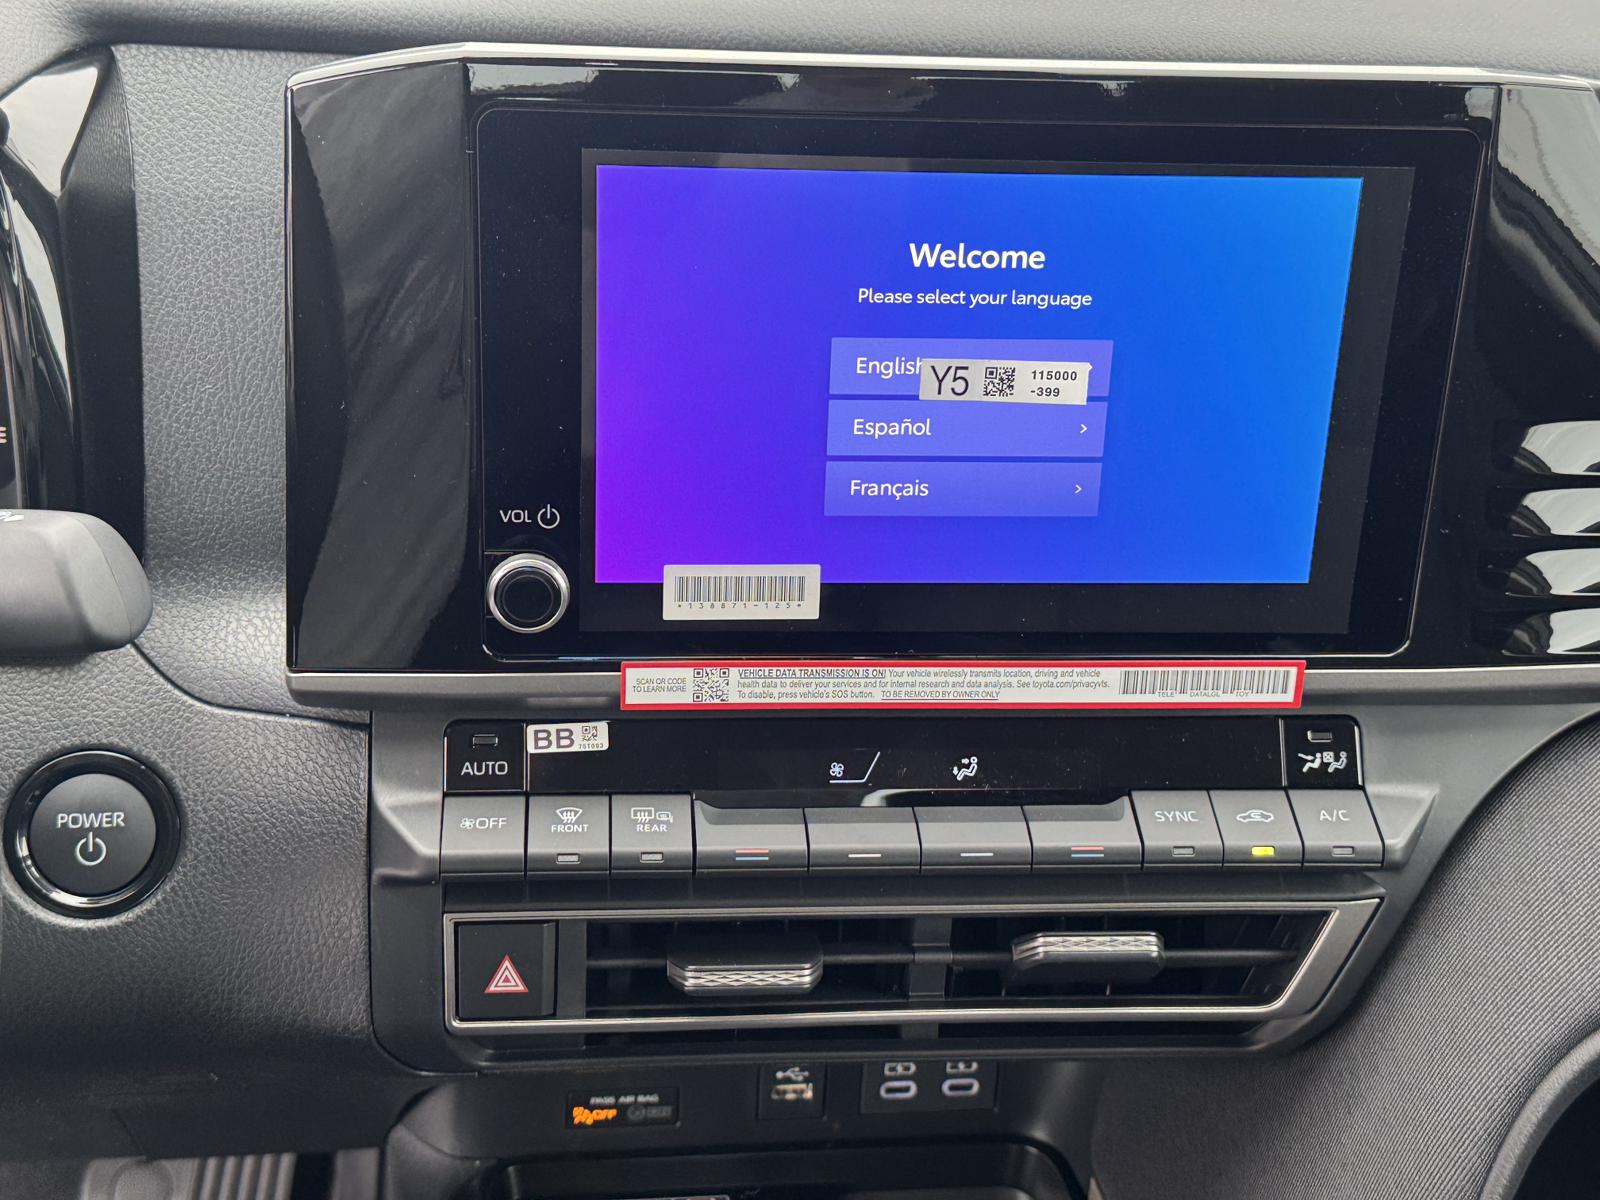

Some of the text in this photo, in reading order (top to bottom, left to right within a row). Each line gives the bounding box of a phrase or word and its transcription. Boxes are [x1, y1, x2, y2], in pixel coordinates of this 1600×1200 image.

[909, 242, 1046, 270] Welcome
[858, 288, 1093, 310] Please select your language
[930, 365, 970, 396] Y5
[1030, 370, 1078, 381] 115000
[1030, 387, 1060, 397] -399
[853, 418, 931, 439] Español
[850, 479, 929, 500] Français
[499, 509, 532, 523] VOL
[738, 669, 1100, 679] VEHICLE DATA TRANSMISSION IS ON! Your vehicle wirelessly transmits location, driving and vehicle
[738, 680, 760, 688] health
[762, 680, 778, 688] data
[780, 680, 787, 688] to
[789, 680, 813, 688] deliver
[814, 681, 830, 690] your
[832, 680, 861, 688] services
[864, 680, 876, 688] and
[878, 680, 888, 688] for
[890, 680, 916, 688] internal
[918, 680, 950, 688] research
[951, 680, 964, 688] and
[966, 680, 982, 688] data
[984, 680, 1014, 689] analysis.
[1016, 680, 1030, 688] See
[738, 690, 746, 698] To
[748, 690, 776, 699] disable,
[778, 692, 798, 700] press
[799, 690, 830, 698] vehicle's
[832, 690, 848, 698] SOS
[850, 690, 875, 698] button.
[533, 728, 575, 750] BB
[461, 761, 509, 776] AUTO
[56, 811, 126, 829] POWER
[1154, 810, 1199, 822] SYNC
[1319, 809, 1350, 821] A/C
[475, 817, 508, 829] OFF
[551, 824, 589, 833] FRONT
[636, 823, 668, 832] REAR
